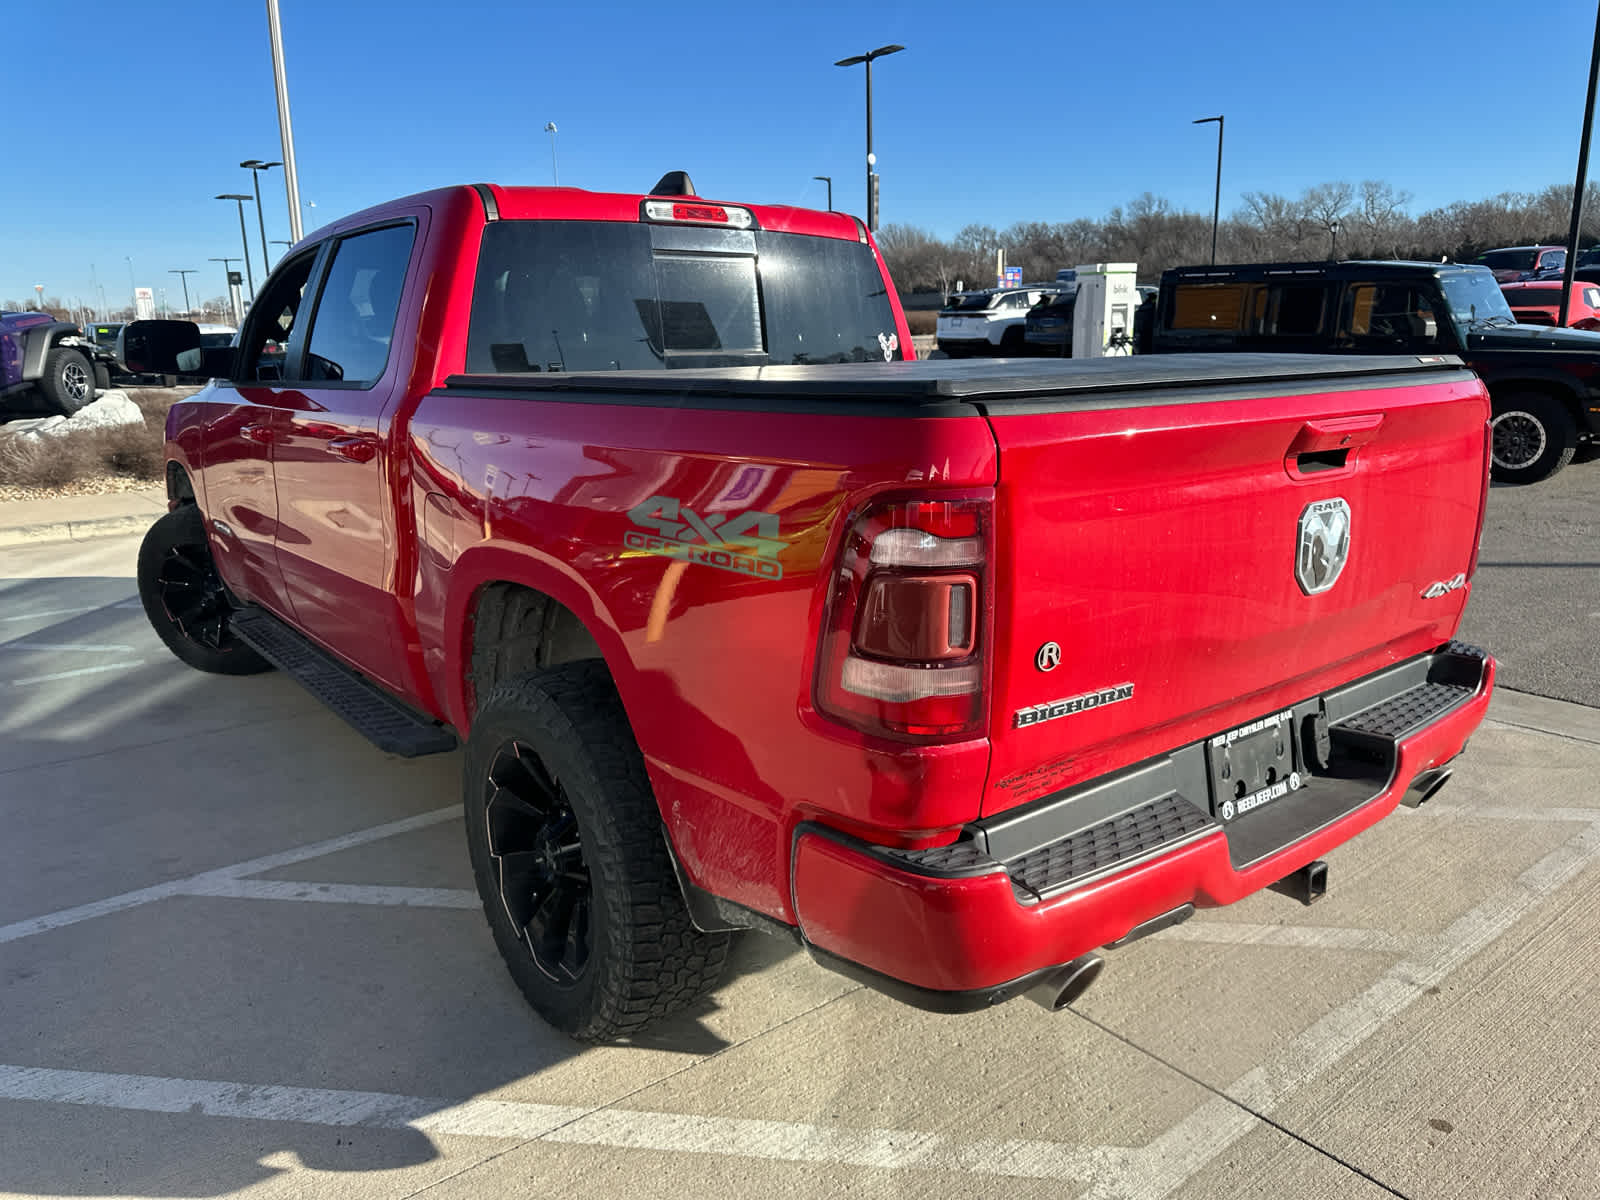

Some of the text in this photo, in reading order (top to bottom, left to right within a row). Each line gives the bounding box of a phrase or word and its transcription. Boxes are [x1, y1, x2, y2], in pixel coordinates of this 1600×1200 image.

[1312, 501, 1343, 513] RAM
[624, 531, 783, 580] OFF ROAD
[1038, 642, 1062, 671] R
[1014, 683, 1135, 728] BIGHORN
